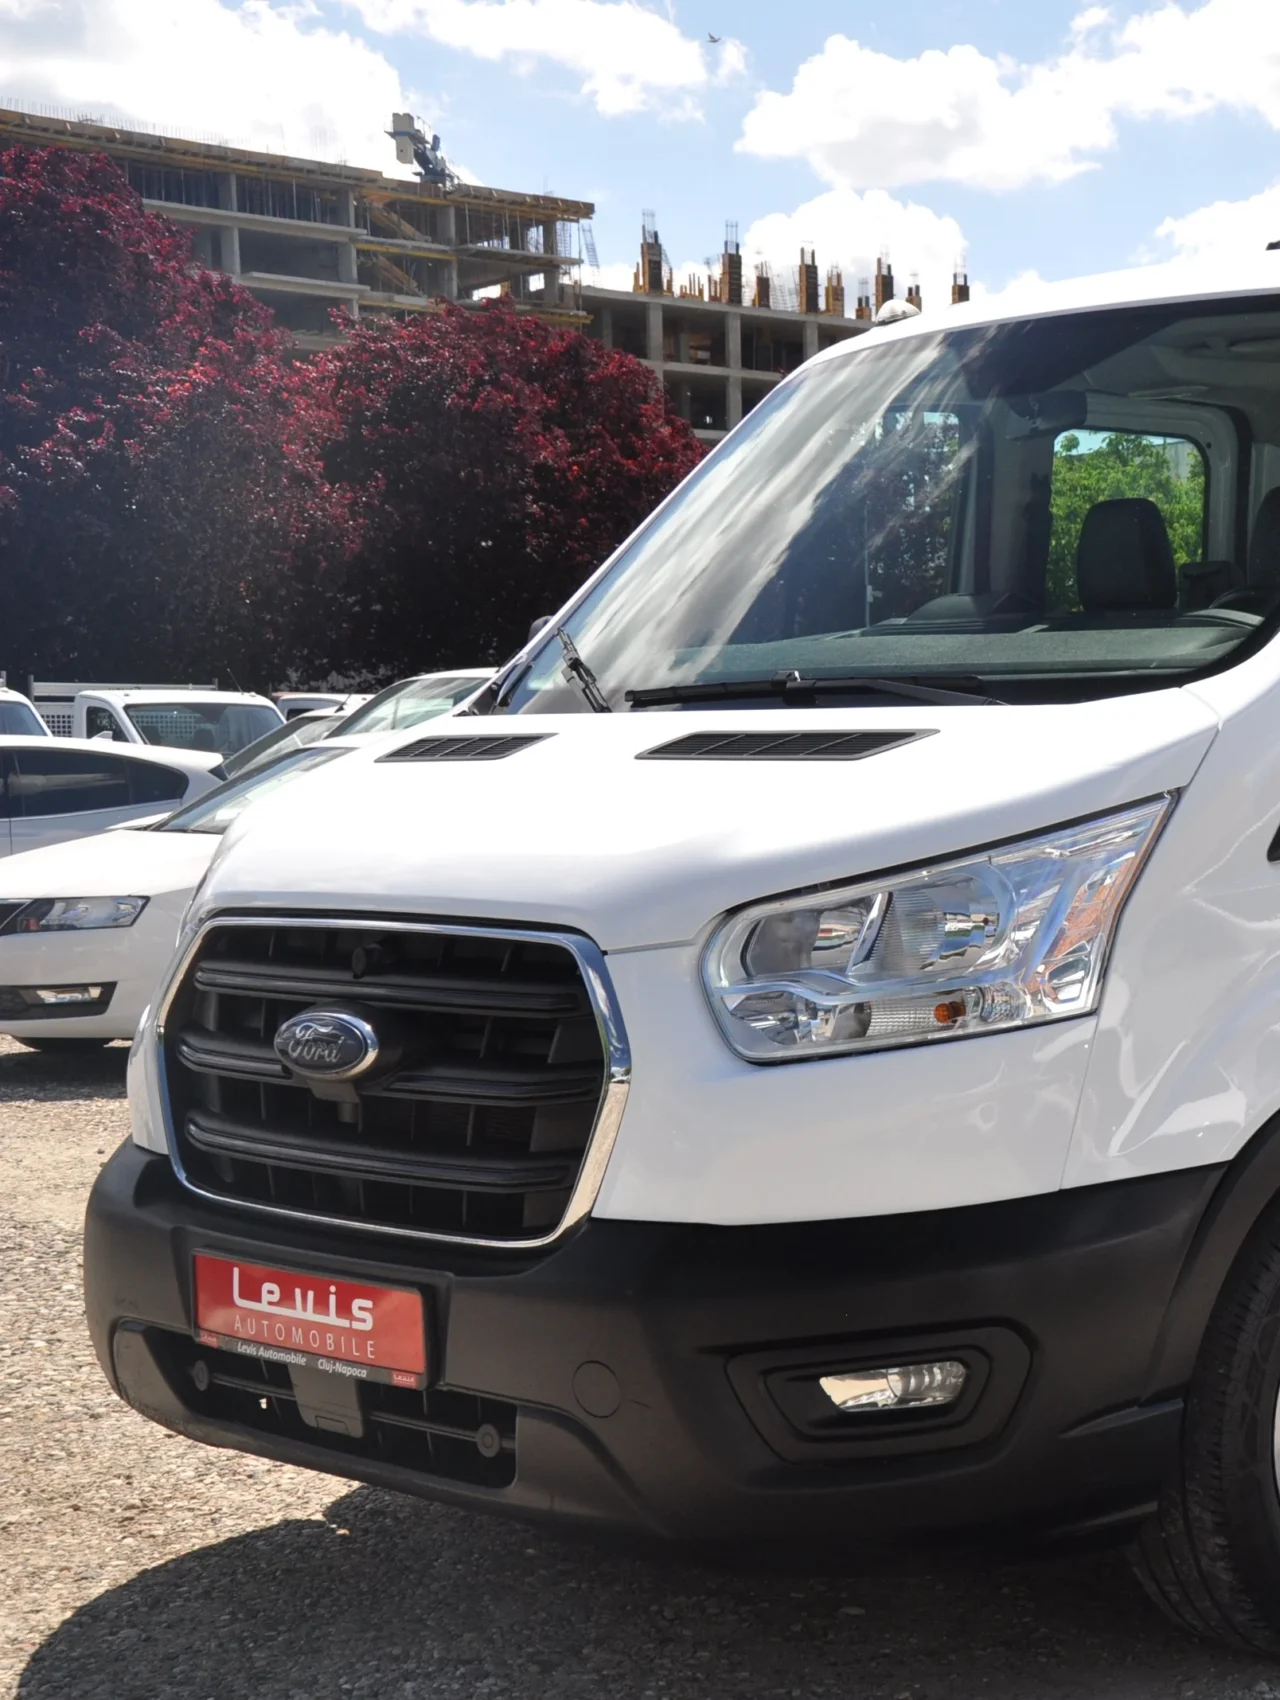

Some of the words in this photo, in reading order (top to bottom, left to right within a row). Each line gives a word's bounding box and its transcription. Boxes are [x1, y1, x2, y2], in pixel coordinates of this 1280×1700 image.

[288, 1021, 346, 1062] Ford
[232, 1266, 374, 1332] Levis
[234, 1315, 376, 1359] AUTOMOBILE
[237, 1340, 257, 1355] Levis
[257, 1345, 307, 1366] Automobile
[317, 1358, 367, 1378] Cluj-Napoca
